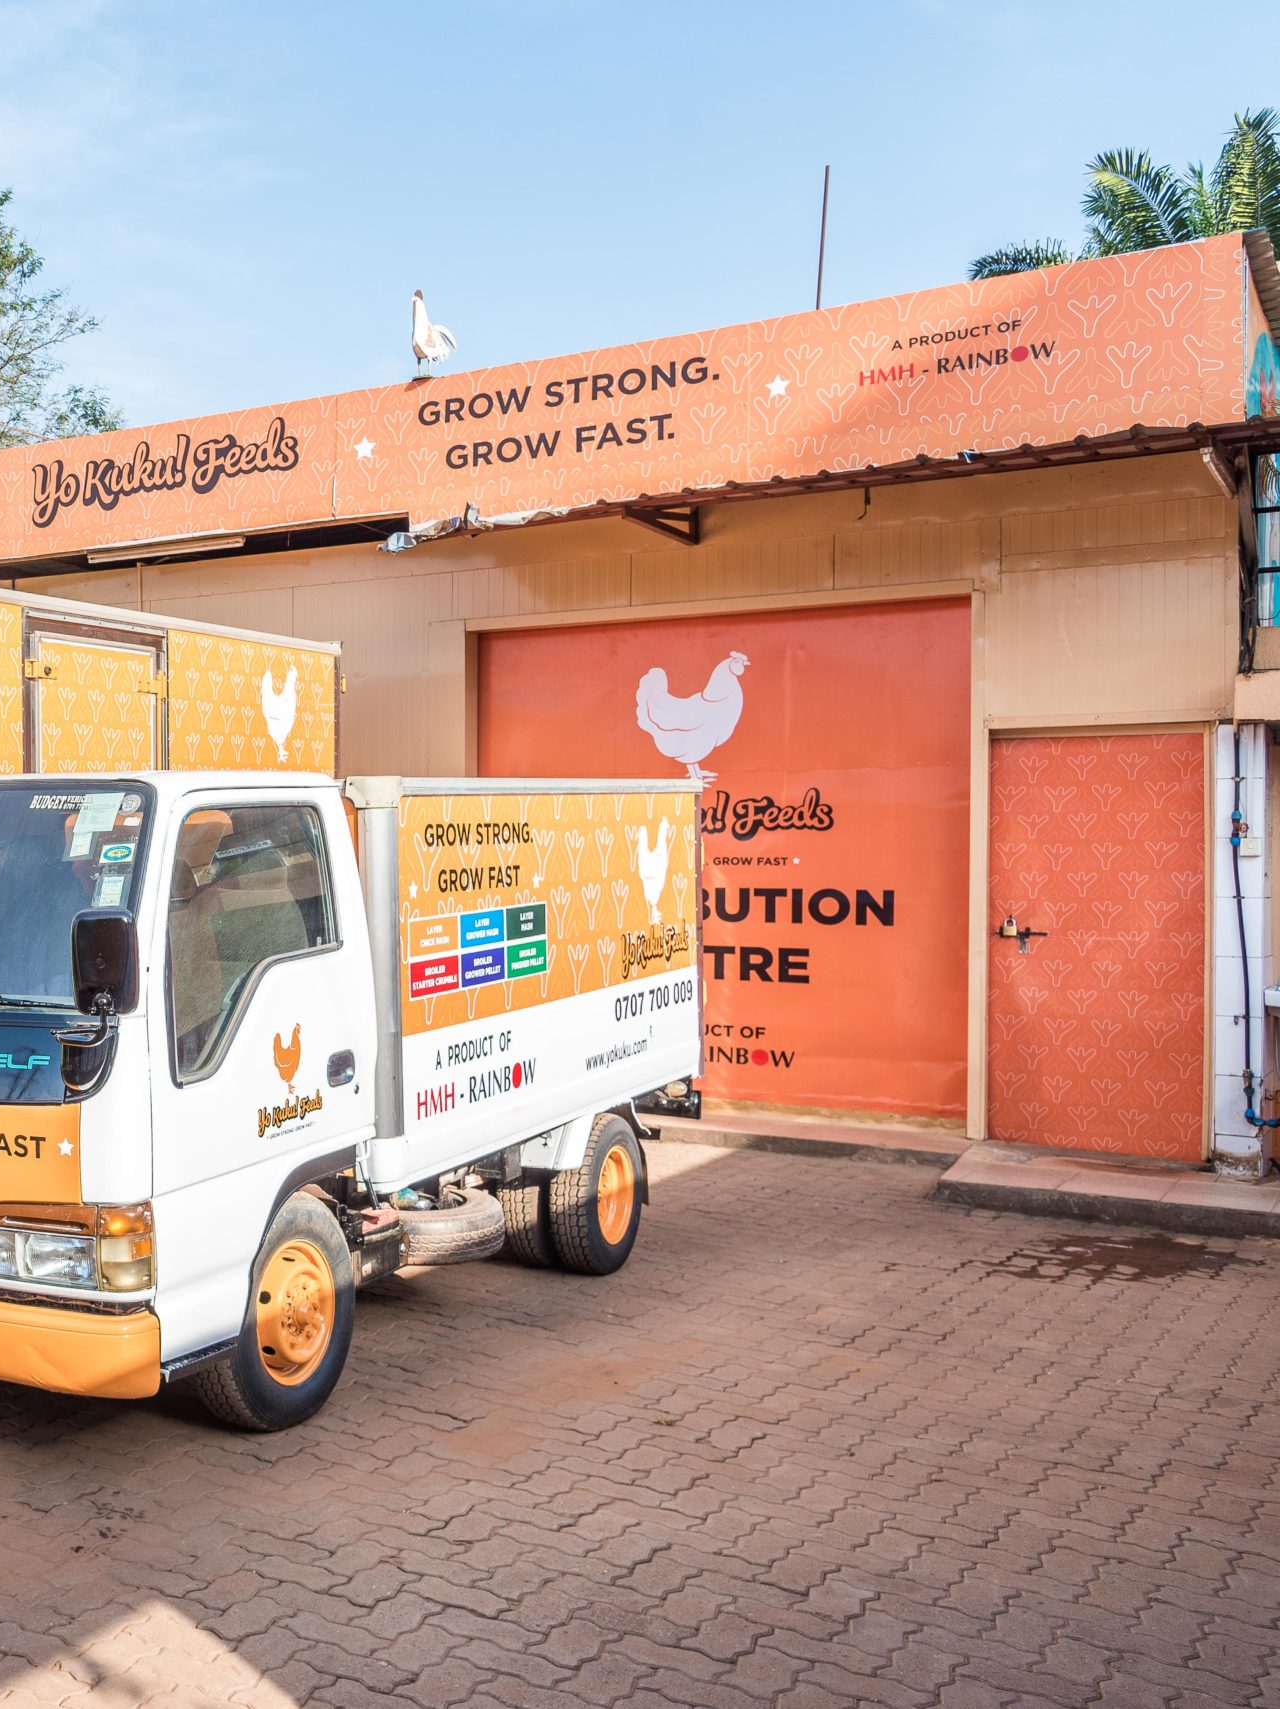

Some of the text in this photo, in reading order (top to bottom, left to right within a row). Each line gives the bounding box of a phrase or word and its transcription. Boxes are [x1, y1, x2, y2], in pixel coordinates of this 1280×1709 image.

[891, 320, 1022, 351] A PRODUCT OF
[859, 363, 914, 386] HMH
[418, 356, 720, 426] GROW STRONG.
[445, 413, 675, 469] GROW FAST.
[32, 417, 299, 528] Yo Kuku! Feeds
[30, 795, 67, 809] BUDGET
[732, 788, 834, 841] Feeds
[424, 822, 534, 847] GROW STRONG.
[713, 857, 788, 866] GROW FAST
[438, 865, 520, 893] GROW FAST
[474, 918, 490, 928] LAYER
[520, 911, 534, 921] LAYER
[427, 925, 443, 935] LAYER
[466, 927, 499, 940] GROWER MASH
[521, 922, 533, 931] MASH
[519, 947, 537, 958] BROILER
[621, 919, 689, 979] Yo Kuku! Feeds
[425, 965, 446, 976] BROILER
[473, 955, 493, 967] BROILER
[530, 956, 545, 967] PELLET
[464, 964, 501, 979] GROWER PELLET
[412, 974, 458, 990] STARTER CRUMBLE
[614, 980, 693, 1021] 0707 700 009
[740, 1026, 766, 1039] OF
[435, 1030, 511, 1070] A PRODUCT OF
[585, 1039, 648, 1071] www.yokuku.com
[417, 1082, 455, 1120] HMH
[258, 1088, 322, 1137] Yo Kuku! Feeds
